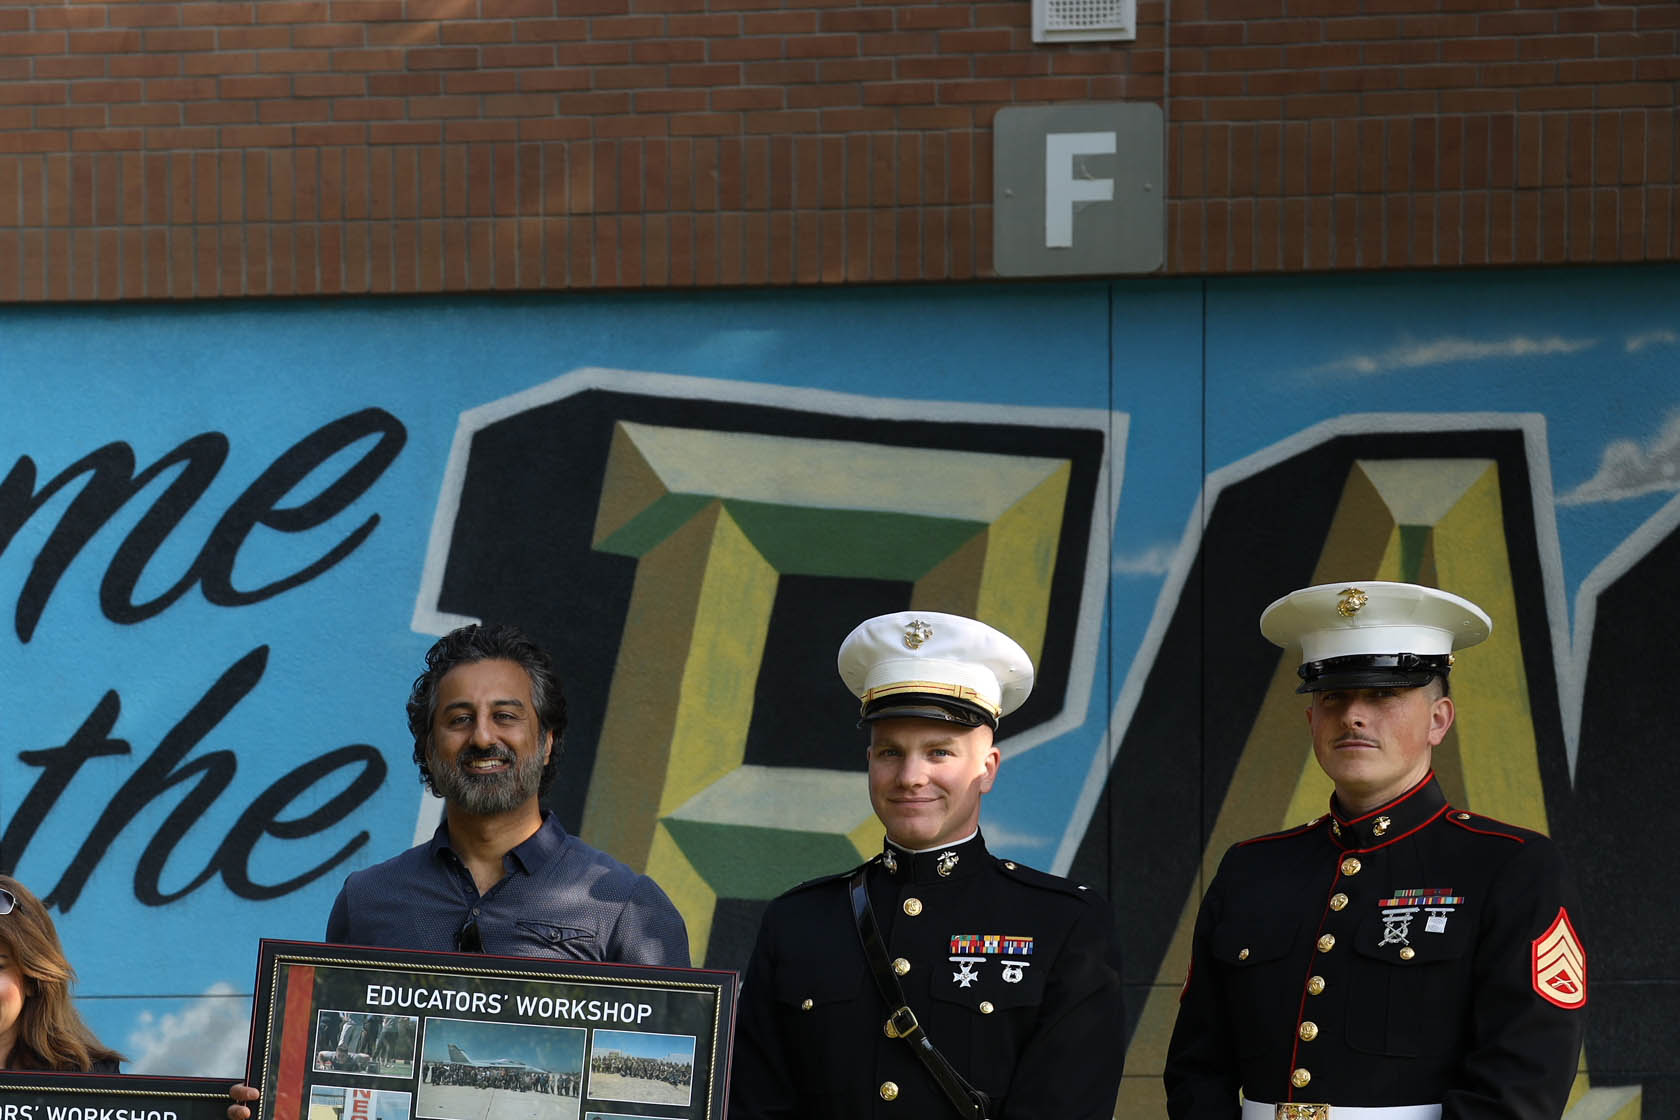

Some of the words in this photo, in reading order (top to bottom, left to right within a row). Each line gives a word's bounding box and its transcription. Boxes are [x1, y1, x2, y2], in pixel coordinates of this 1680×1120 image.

[1046, 132, 1116, 247] F
[366, 985, 508, 1014] EDUCATORS’
[516, 994, 652, 1024] WORKSHOP
